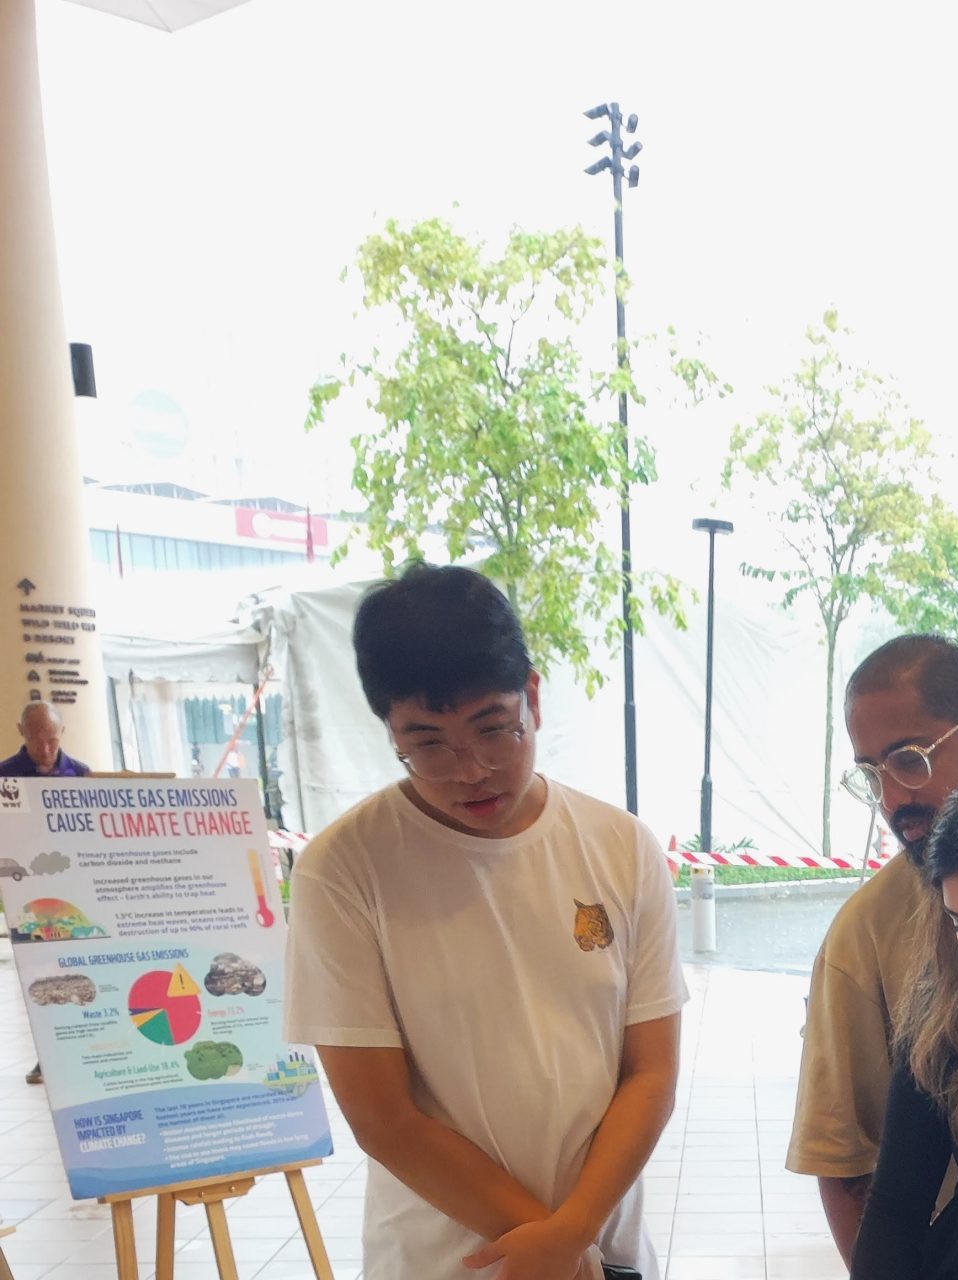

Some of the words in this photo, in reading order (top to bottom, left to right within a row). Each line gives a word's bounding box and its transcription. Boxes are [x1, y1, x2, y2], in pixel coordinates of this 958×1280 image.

[41, 788, 136, 809] GREENHOUSE
[138, 788, 165, 808] GAS
[168, 787, 238, 808] EMISSIONS
[46, 812, 95, 833] CAUSE
[100, 811, 181, 838] CLIMATE
[184, 810, 253, 836] CHANGE
[58, 955, 88, 968] GLOBAL
[88, 952, 135, 967] GREENHOUSE
[136, 951, 151, 962] GAS
[151, 948, 189, 961] EMISSIONS
[82, 1009, 102, 1019] Waste
[74, 1116, 93, 1128] HOW
[95, 1115, 102, 1125] IS
[103, 1110, 143, 1125] SINGAPORE
[77, 1125, 116, 1140] IMPACTED
[117, 1124, 127, 1135] BY
[80, 1138, 112, 1152] CLIMATE
